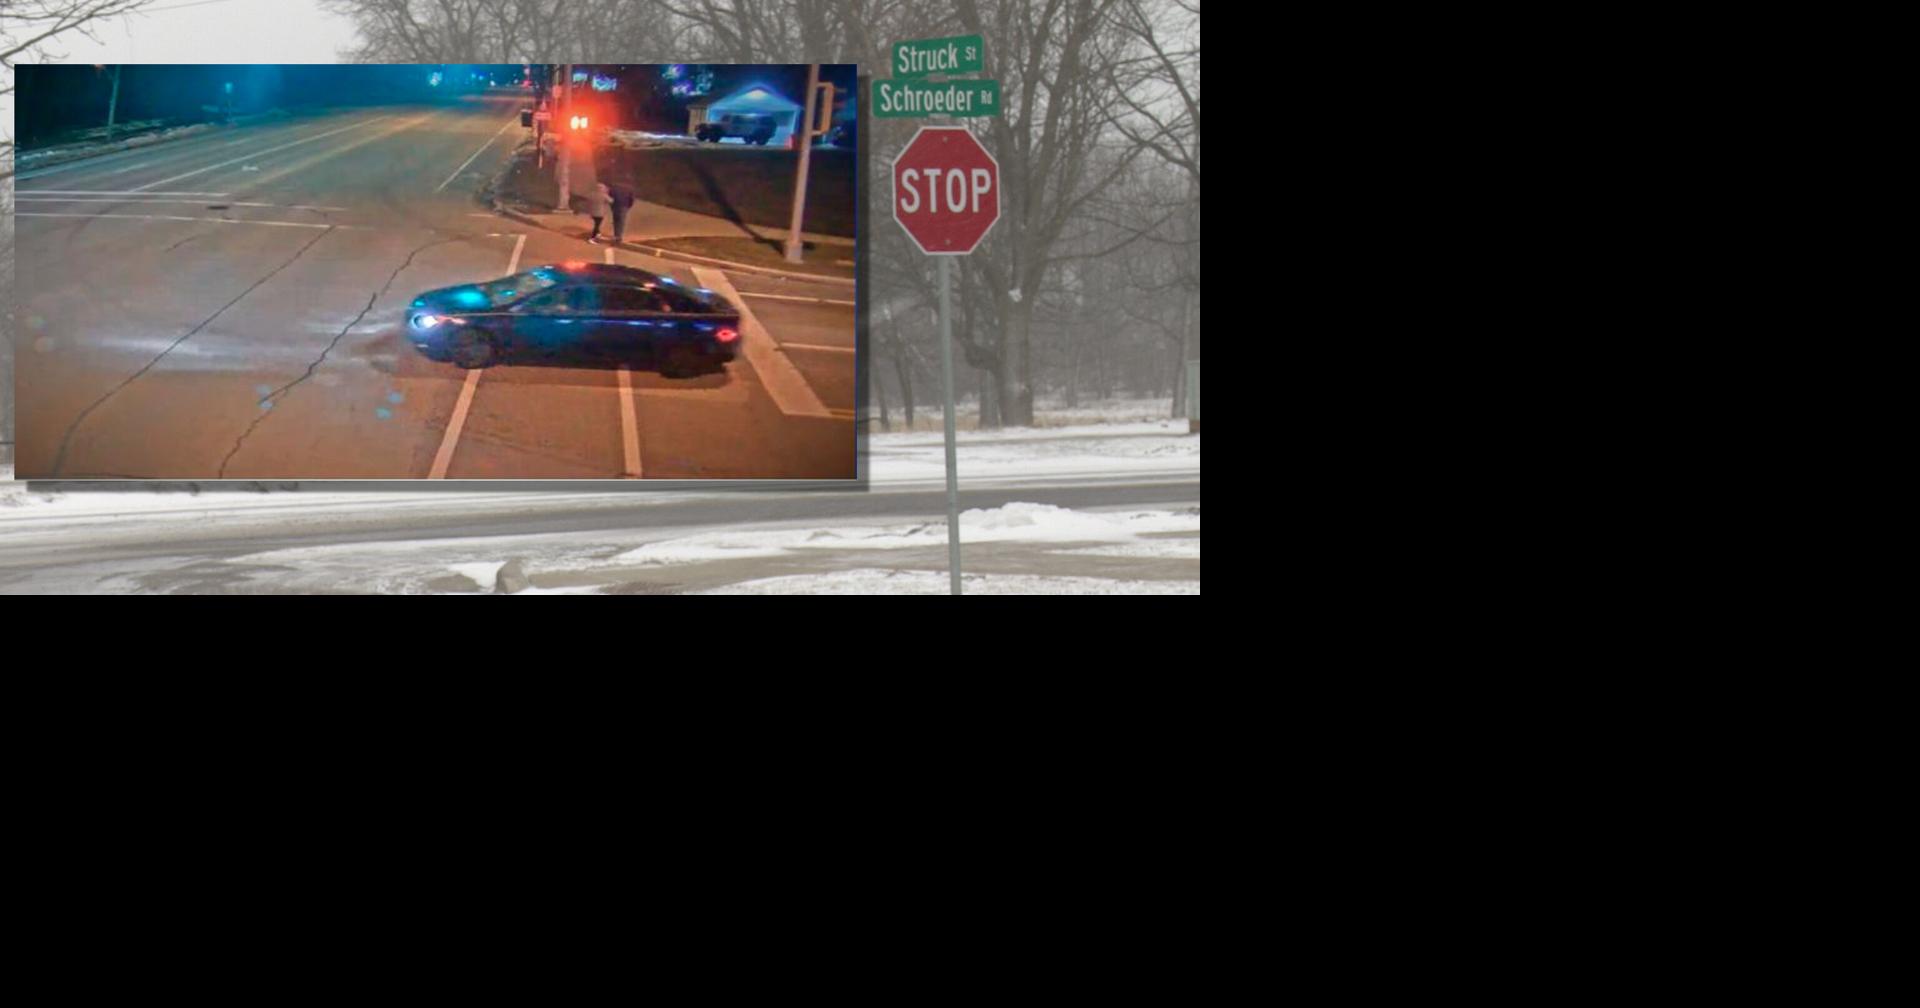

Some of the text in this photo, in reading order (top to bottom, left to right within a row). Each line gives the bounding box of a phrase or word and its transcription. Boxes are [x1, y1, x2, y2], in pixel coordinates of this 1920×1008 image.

[898, 43, 976, 73] Struck St
[880, 84, 992, 112] Schroeder Rd
[900, 168, 991, 213] STOP
